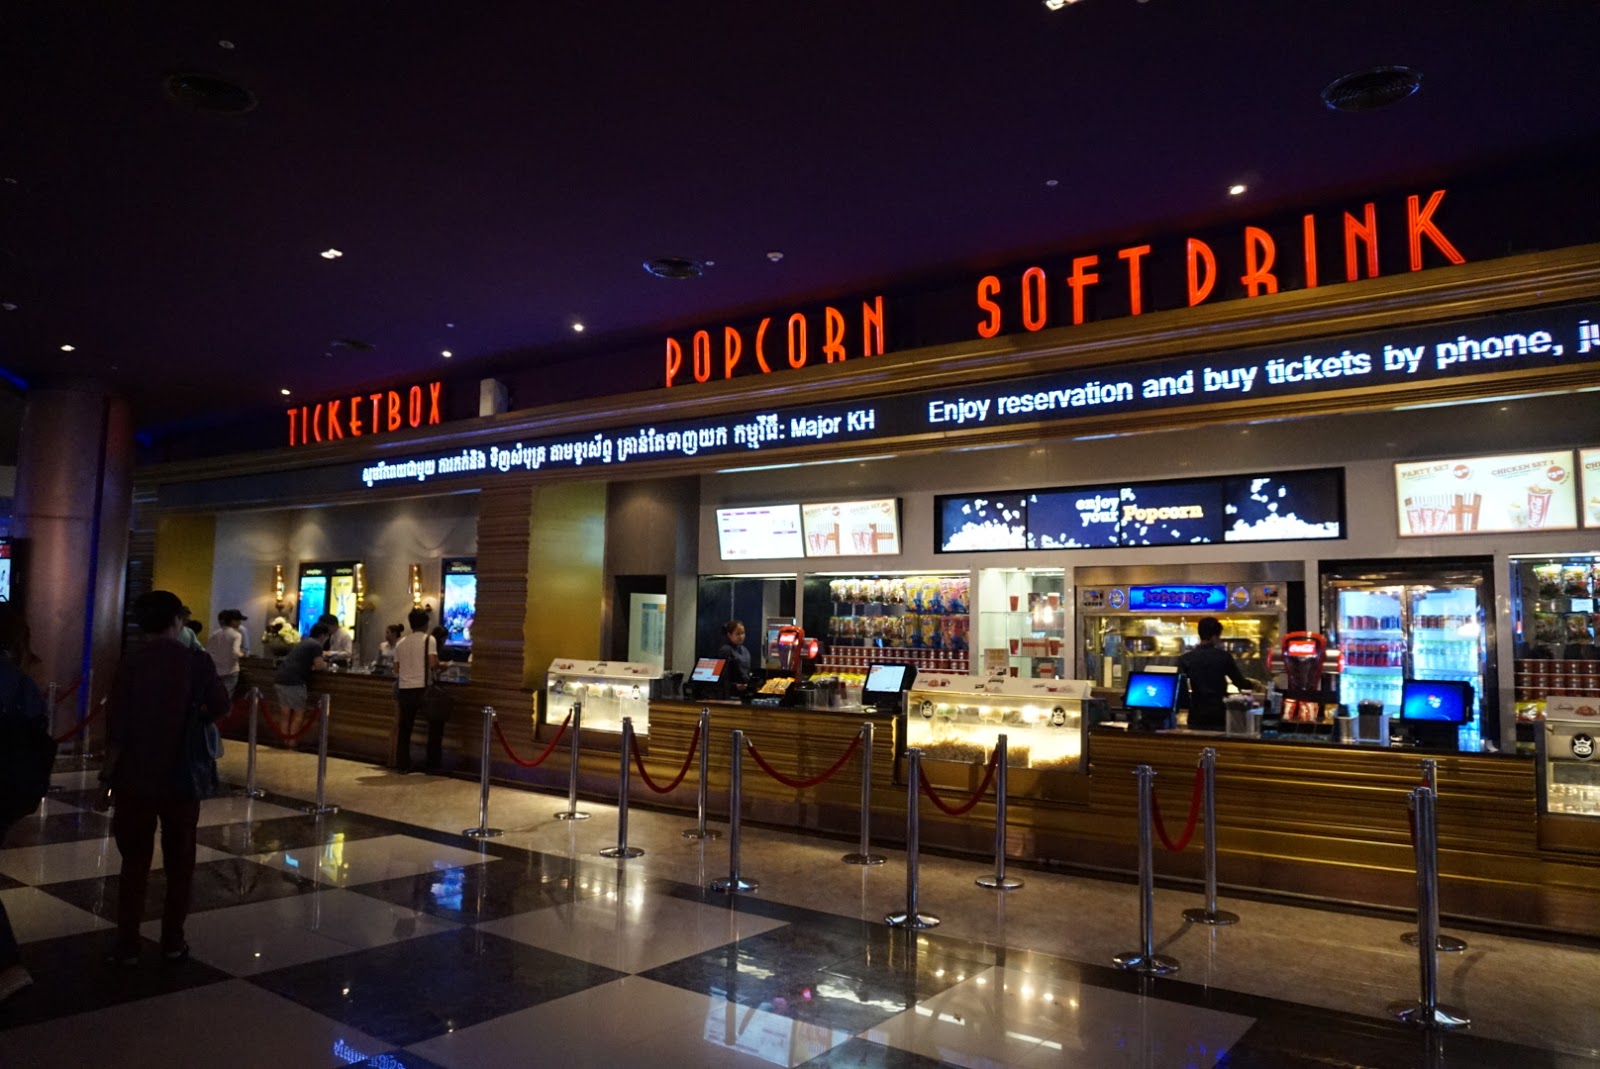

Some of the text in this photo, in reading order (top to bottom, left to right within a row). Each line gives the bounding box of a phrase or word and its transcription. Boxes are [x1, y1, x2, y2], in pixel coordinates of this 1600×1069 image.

[976, 190, 1466, 338] SOFT DRINK
[666, 296, 884, 388] POPCORN
[928, 398, 991, 423] Enjoy
[997, 380, 1134, 415] reservation
[1142, 370, 1194, 399] and
[1203, 366, 1258, 392] buy
[1265, 350, 1372, 384] tickets
[1384, 344, 1425, 373] by
[1436, 330, 1563, 370] phone,
[287, 382, 441, 446] TICKETBOX
[791, 415, 842, 440] Major
[848, 410, 875, 432] KH
[1491, 463, 1530, 476] CHICKEN
[1075, 495, 1119, 513] enjoy
[1080, 511, 1119, 527] your
[1122, 505, 1204, 525] Popcorn
